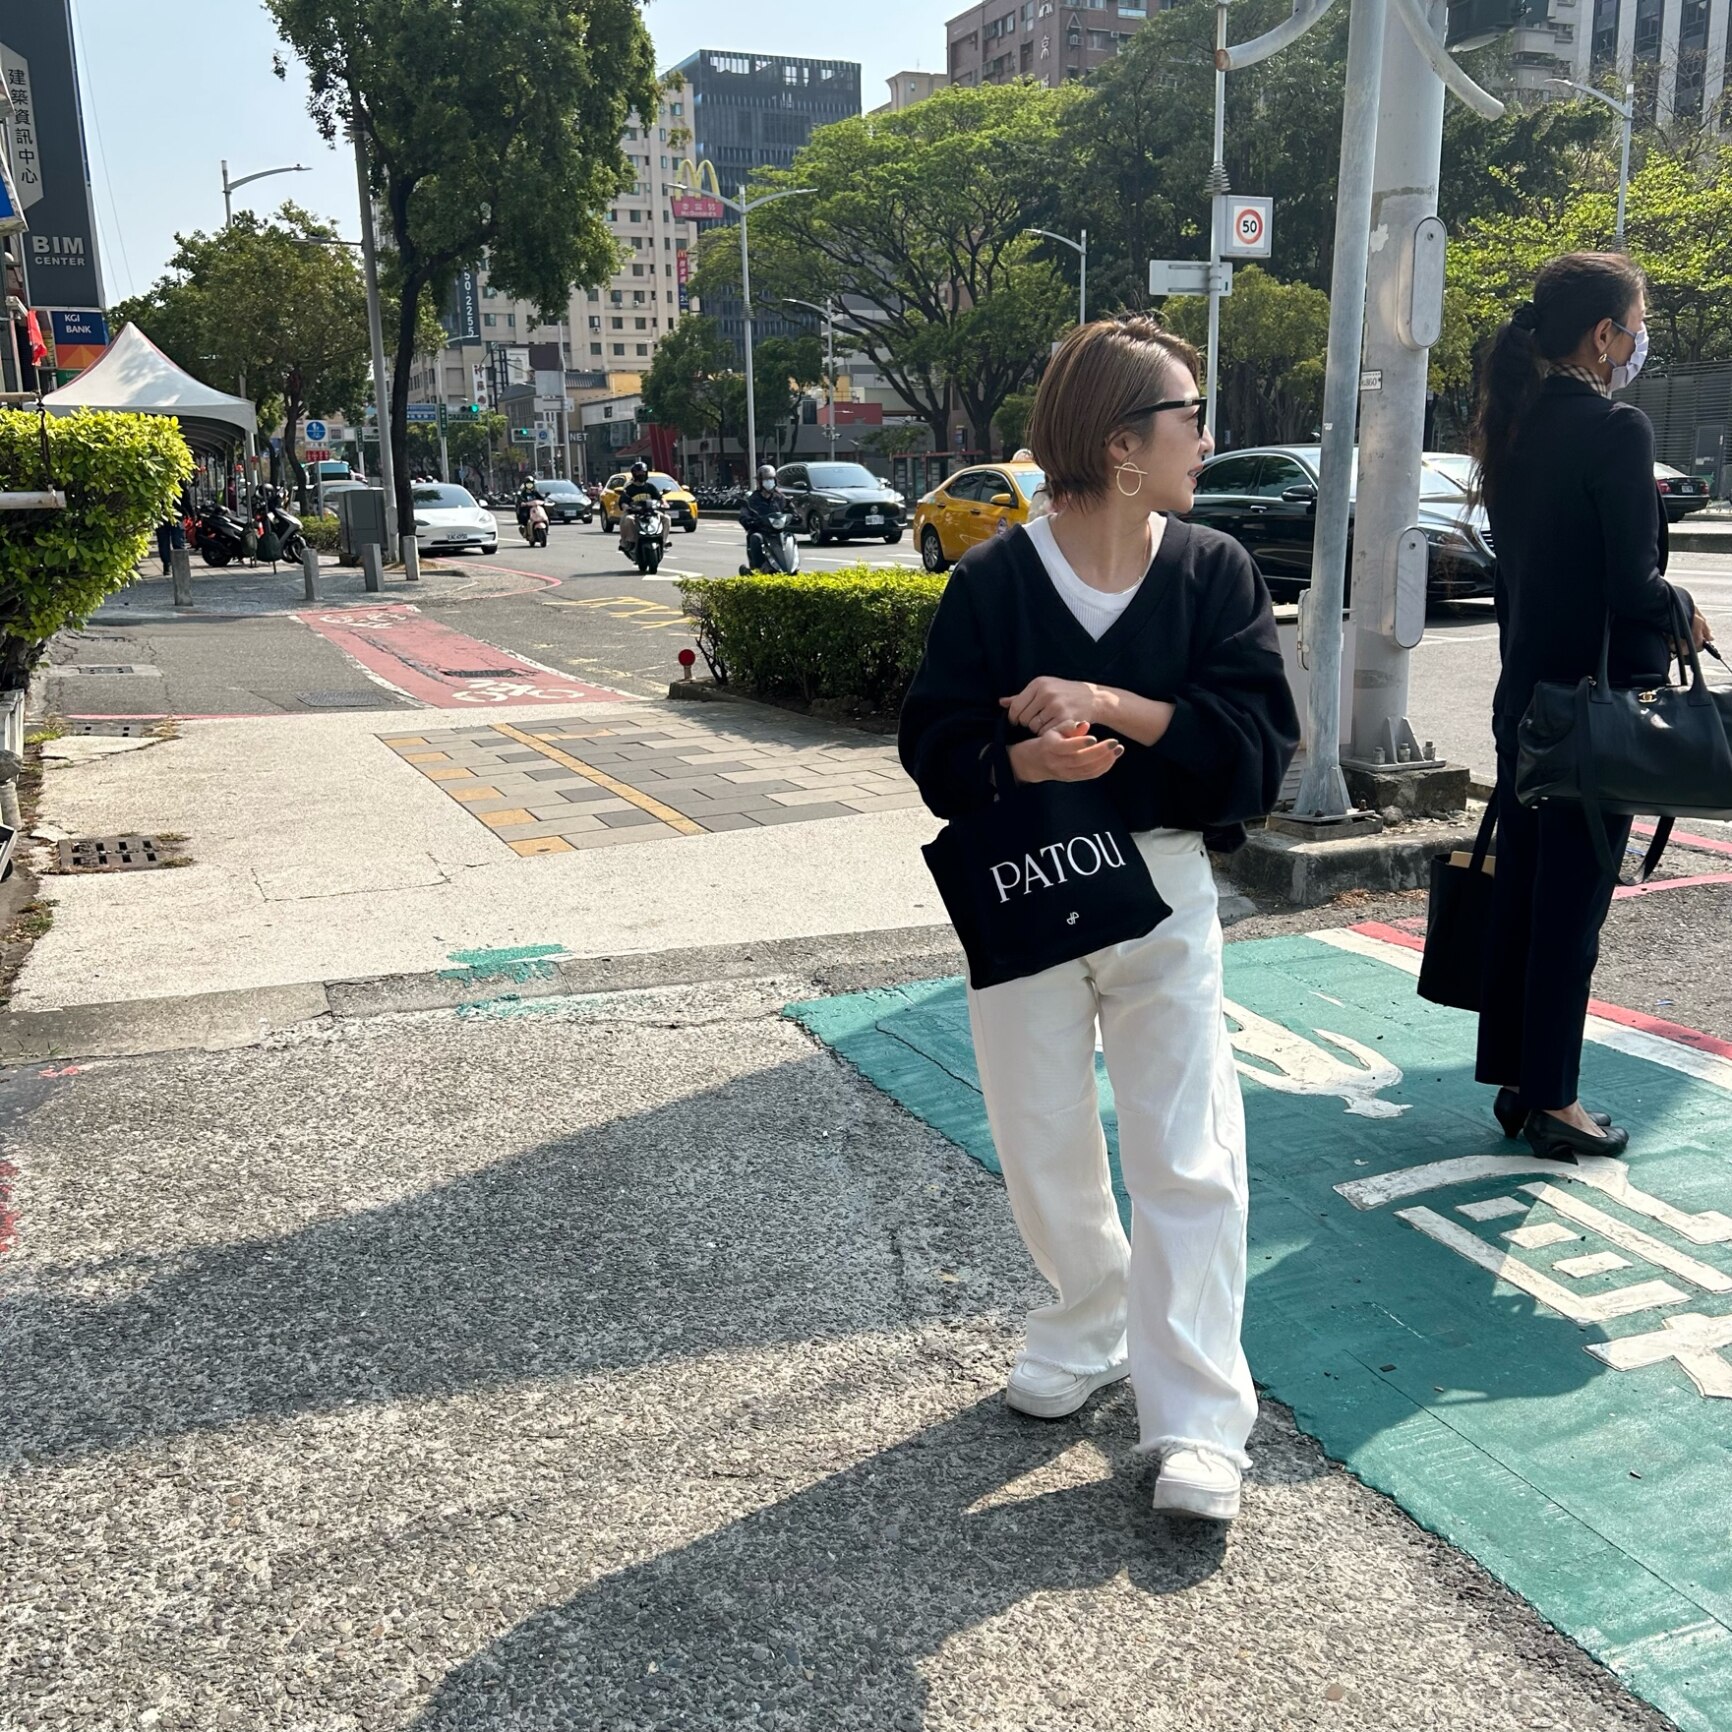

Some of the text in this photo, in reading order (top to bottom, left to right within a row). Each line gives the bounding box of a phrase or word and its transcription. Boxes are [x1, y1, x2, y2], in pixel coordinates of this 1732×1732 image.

[8, 69, 39, 184] 建築資訊中心
[1242, 220, 1258, 233] 50
[32, 235, 85, 255] BIM
[35, 256, 85, 266] CENTER
[64, 314, 81, 323] KGI
[66, 325, 92, 334] BANK
[569, 432, 589, 442] NET
[989, 831, 1127, 903] PATOU
